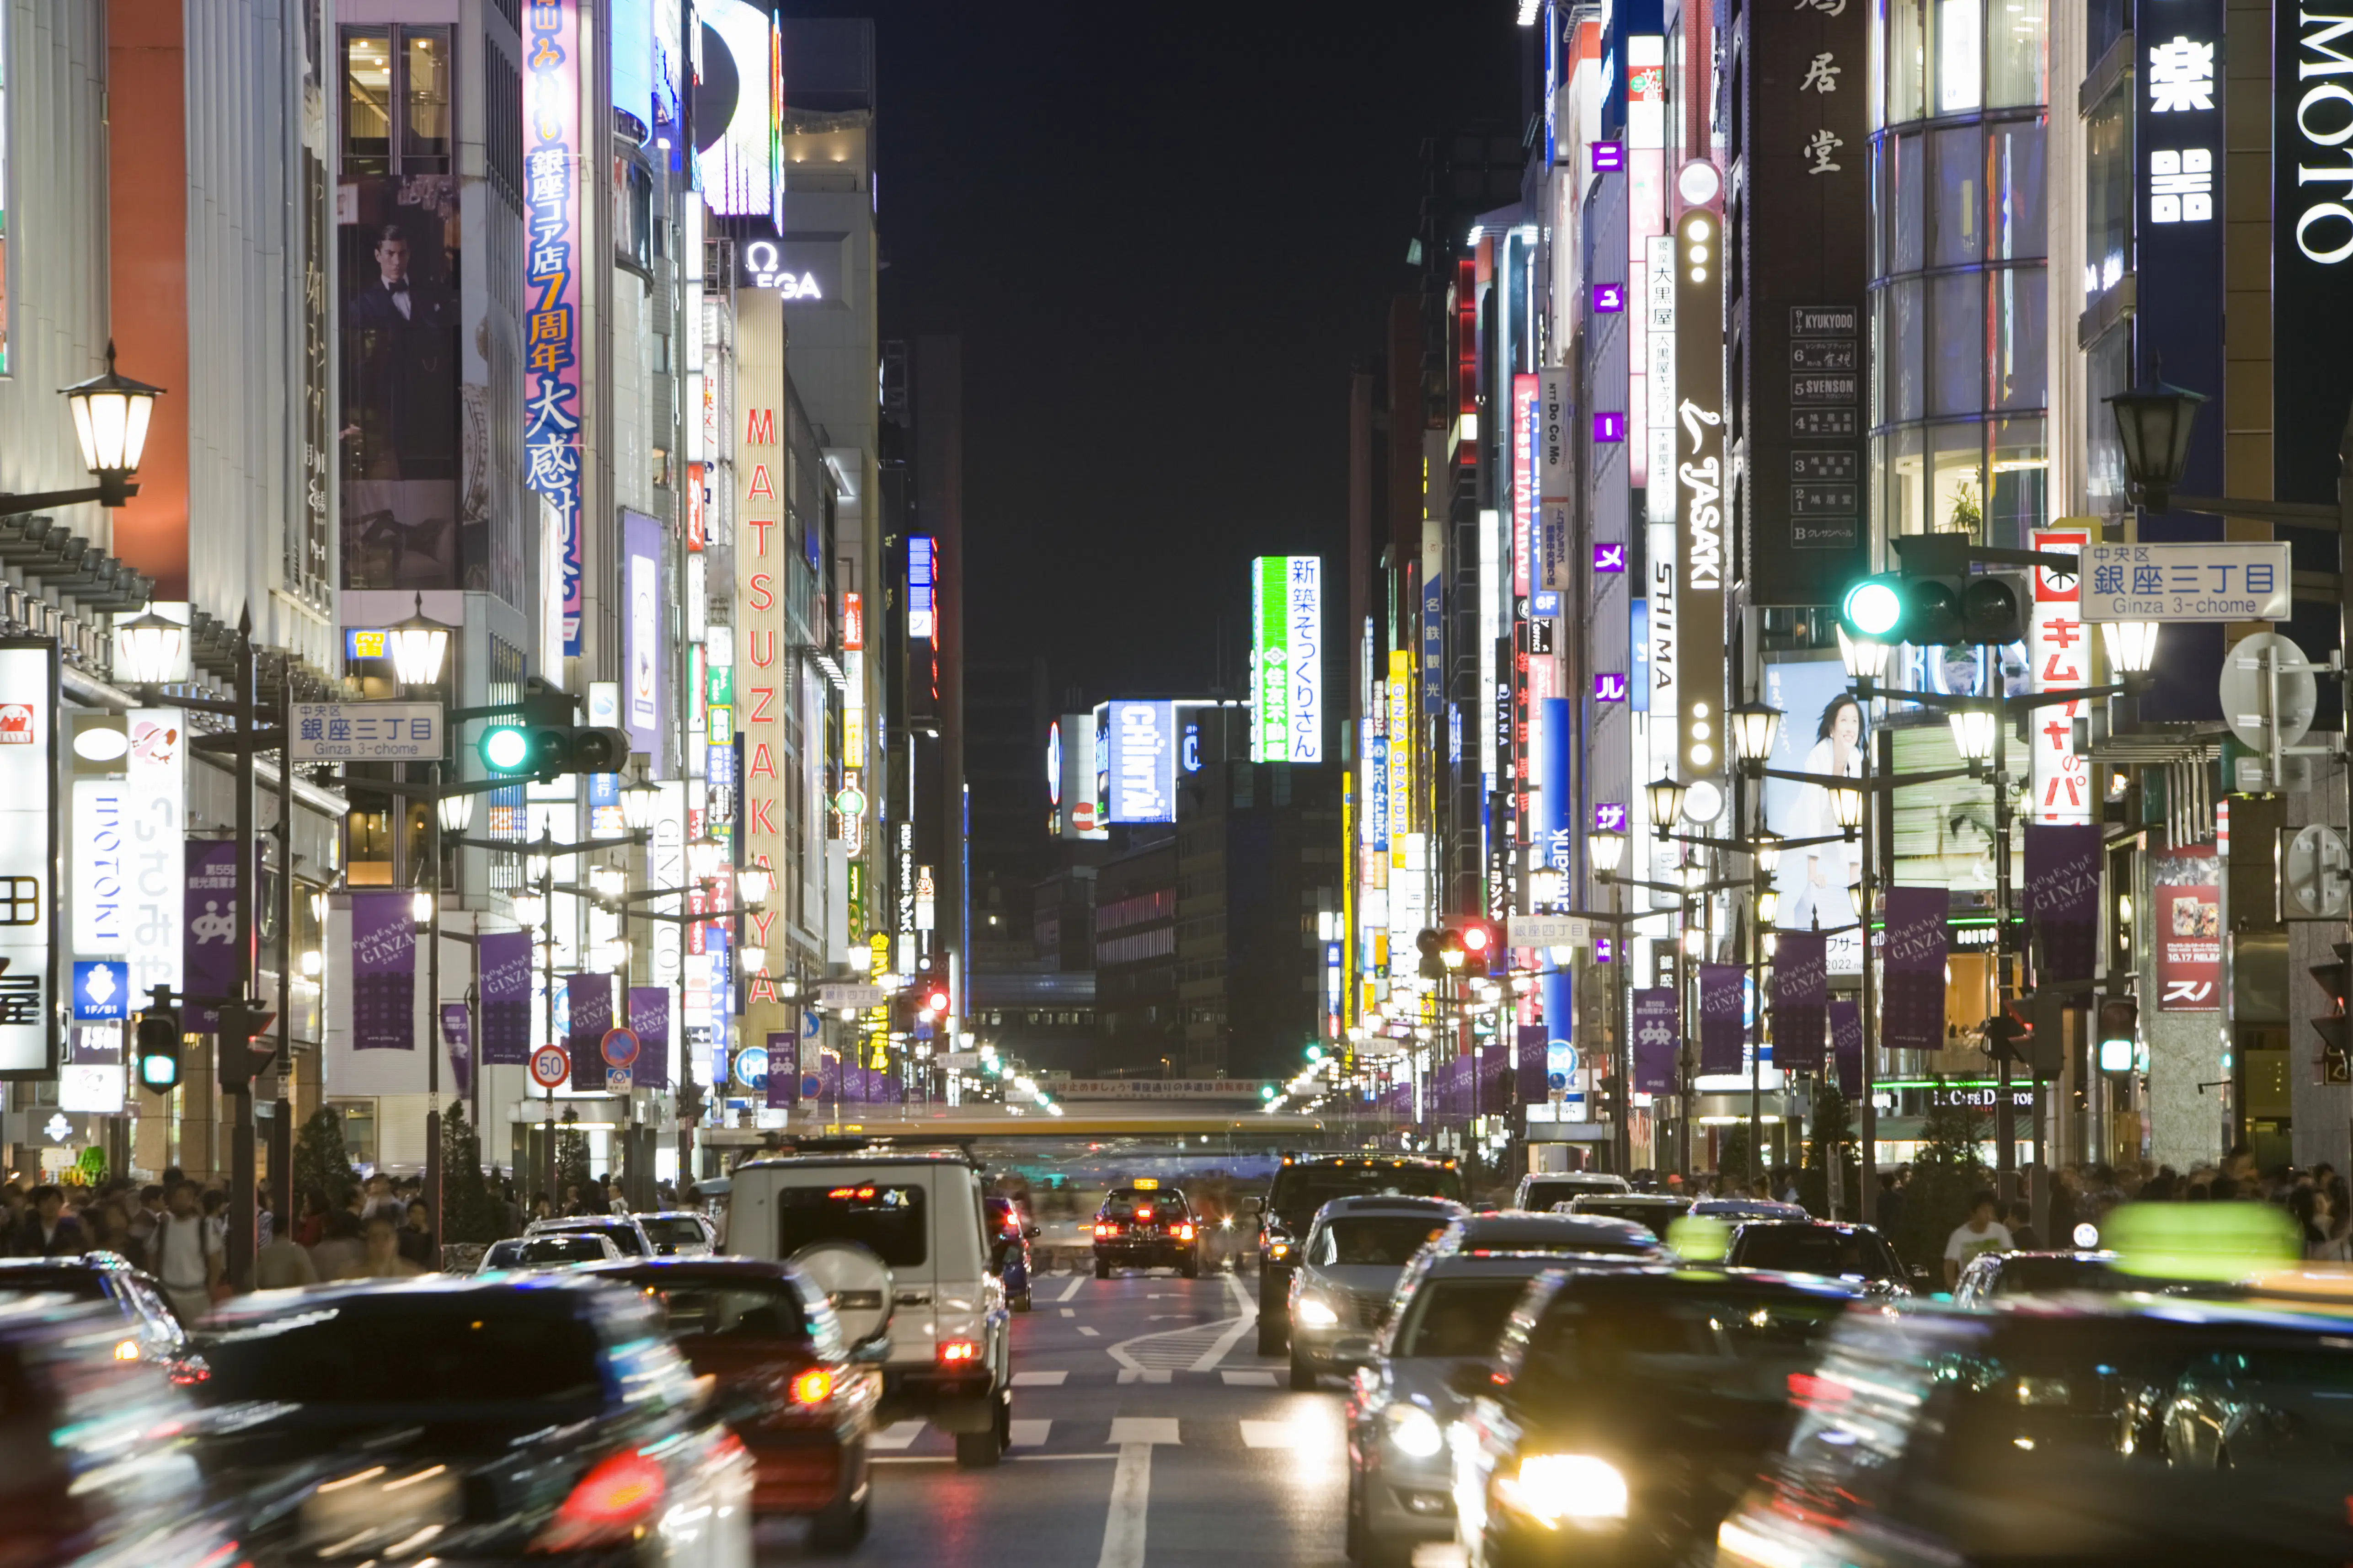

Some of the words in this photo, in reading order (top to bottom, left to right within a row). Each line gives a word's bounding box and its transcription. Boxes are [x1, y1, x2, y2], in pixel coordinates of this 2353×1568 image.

[2150, 37, 2215, 223] 楽器
[2296, 0, 2353, 264] MOTO
[1653, 268, 1672, 325] 大黒屋
[1806, 315, 1852, 328] KYUKYODO
[1794, 350, 1804, 362] 6
[1795, 383, 1804, 395] 5
[1807, 380, 1853, 393] SVENSON
[1795, 417, 1806, 429] 4
[1795, 460, 1805, 472] 3
[1795, 490, 1804, 499] 2
[1679, 457, 1720, 589] TASAKI
[1795, 528, 1806, 540] B
[2093, 547, 2149, 562] 中央区
[2093, 564, 2273, 594] 銀座三丁目
[1536, 596, 1556, 609] 6F
[2112, 597, 2164, 614] Ginza
[2173, 597, 2257, 614] 3-chome
[1656, 561, 1672, 690] SHIMA
[1293, 560, 1316, 757] 新築そっくりさん
[1426, 597, 1440, 697] 名鉄観光
[300, 706, 341, 717] 中央区
[747, 409, 777, 1003] MATSUZAKAYA
[1393, 684, 1406, 743] GINZA
[300, 718, 431, 741] 銀座三丁目
[2043, 618, 2086, 825] キムラヤのパ
[314, 742, 351, 755] Ginza
[358, 742, 418, 755] 3-chome
[1393, 752, 1406, 834] GRANDIR
[2025, 853, 2092, 893] PROMENADE
[1490, 871, 1503, 918] ヨシノヤ
[2034, 873, 2099, 910] GINZA
[2058, 895, 2085, 912] 2007
[353, 917, 410, 949] PROMENADE
[1514, 924, 1583, 936] 銀座四丁目
[1884, 913, 1941, 946] PROMENADE
[361, 931, 416, 964] GINZA
[382, 950, 404, 965] 2007
[1892, 929, 1947, 960] GINZA
[481, 955, 528, 981] PROMENADE
[487, 967, 532, 994] GINZA
[1773, 956, 1823, 984] PROMENADE
[1700, 981, 1741, 1003] PROMENADE
[1781, 970, 1827, 997] GINZA
[575, 1003, 613, 1028] GINZA
[1706, 992, 1745, 1013] GINZA
[635, 1014, 669, 1033] GINZA
[540, 1056, 561, 1076] 50
[1951, 1089, 1981, 1105] CFÉ
